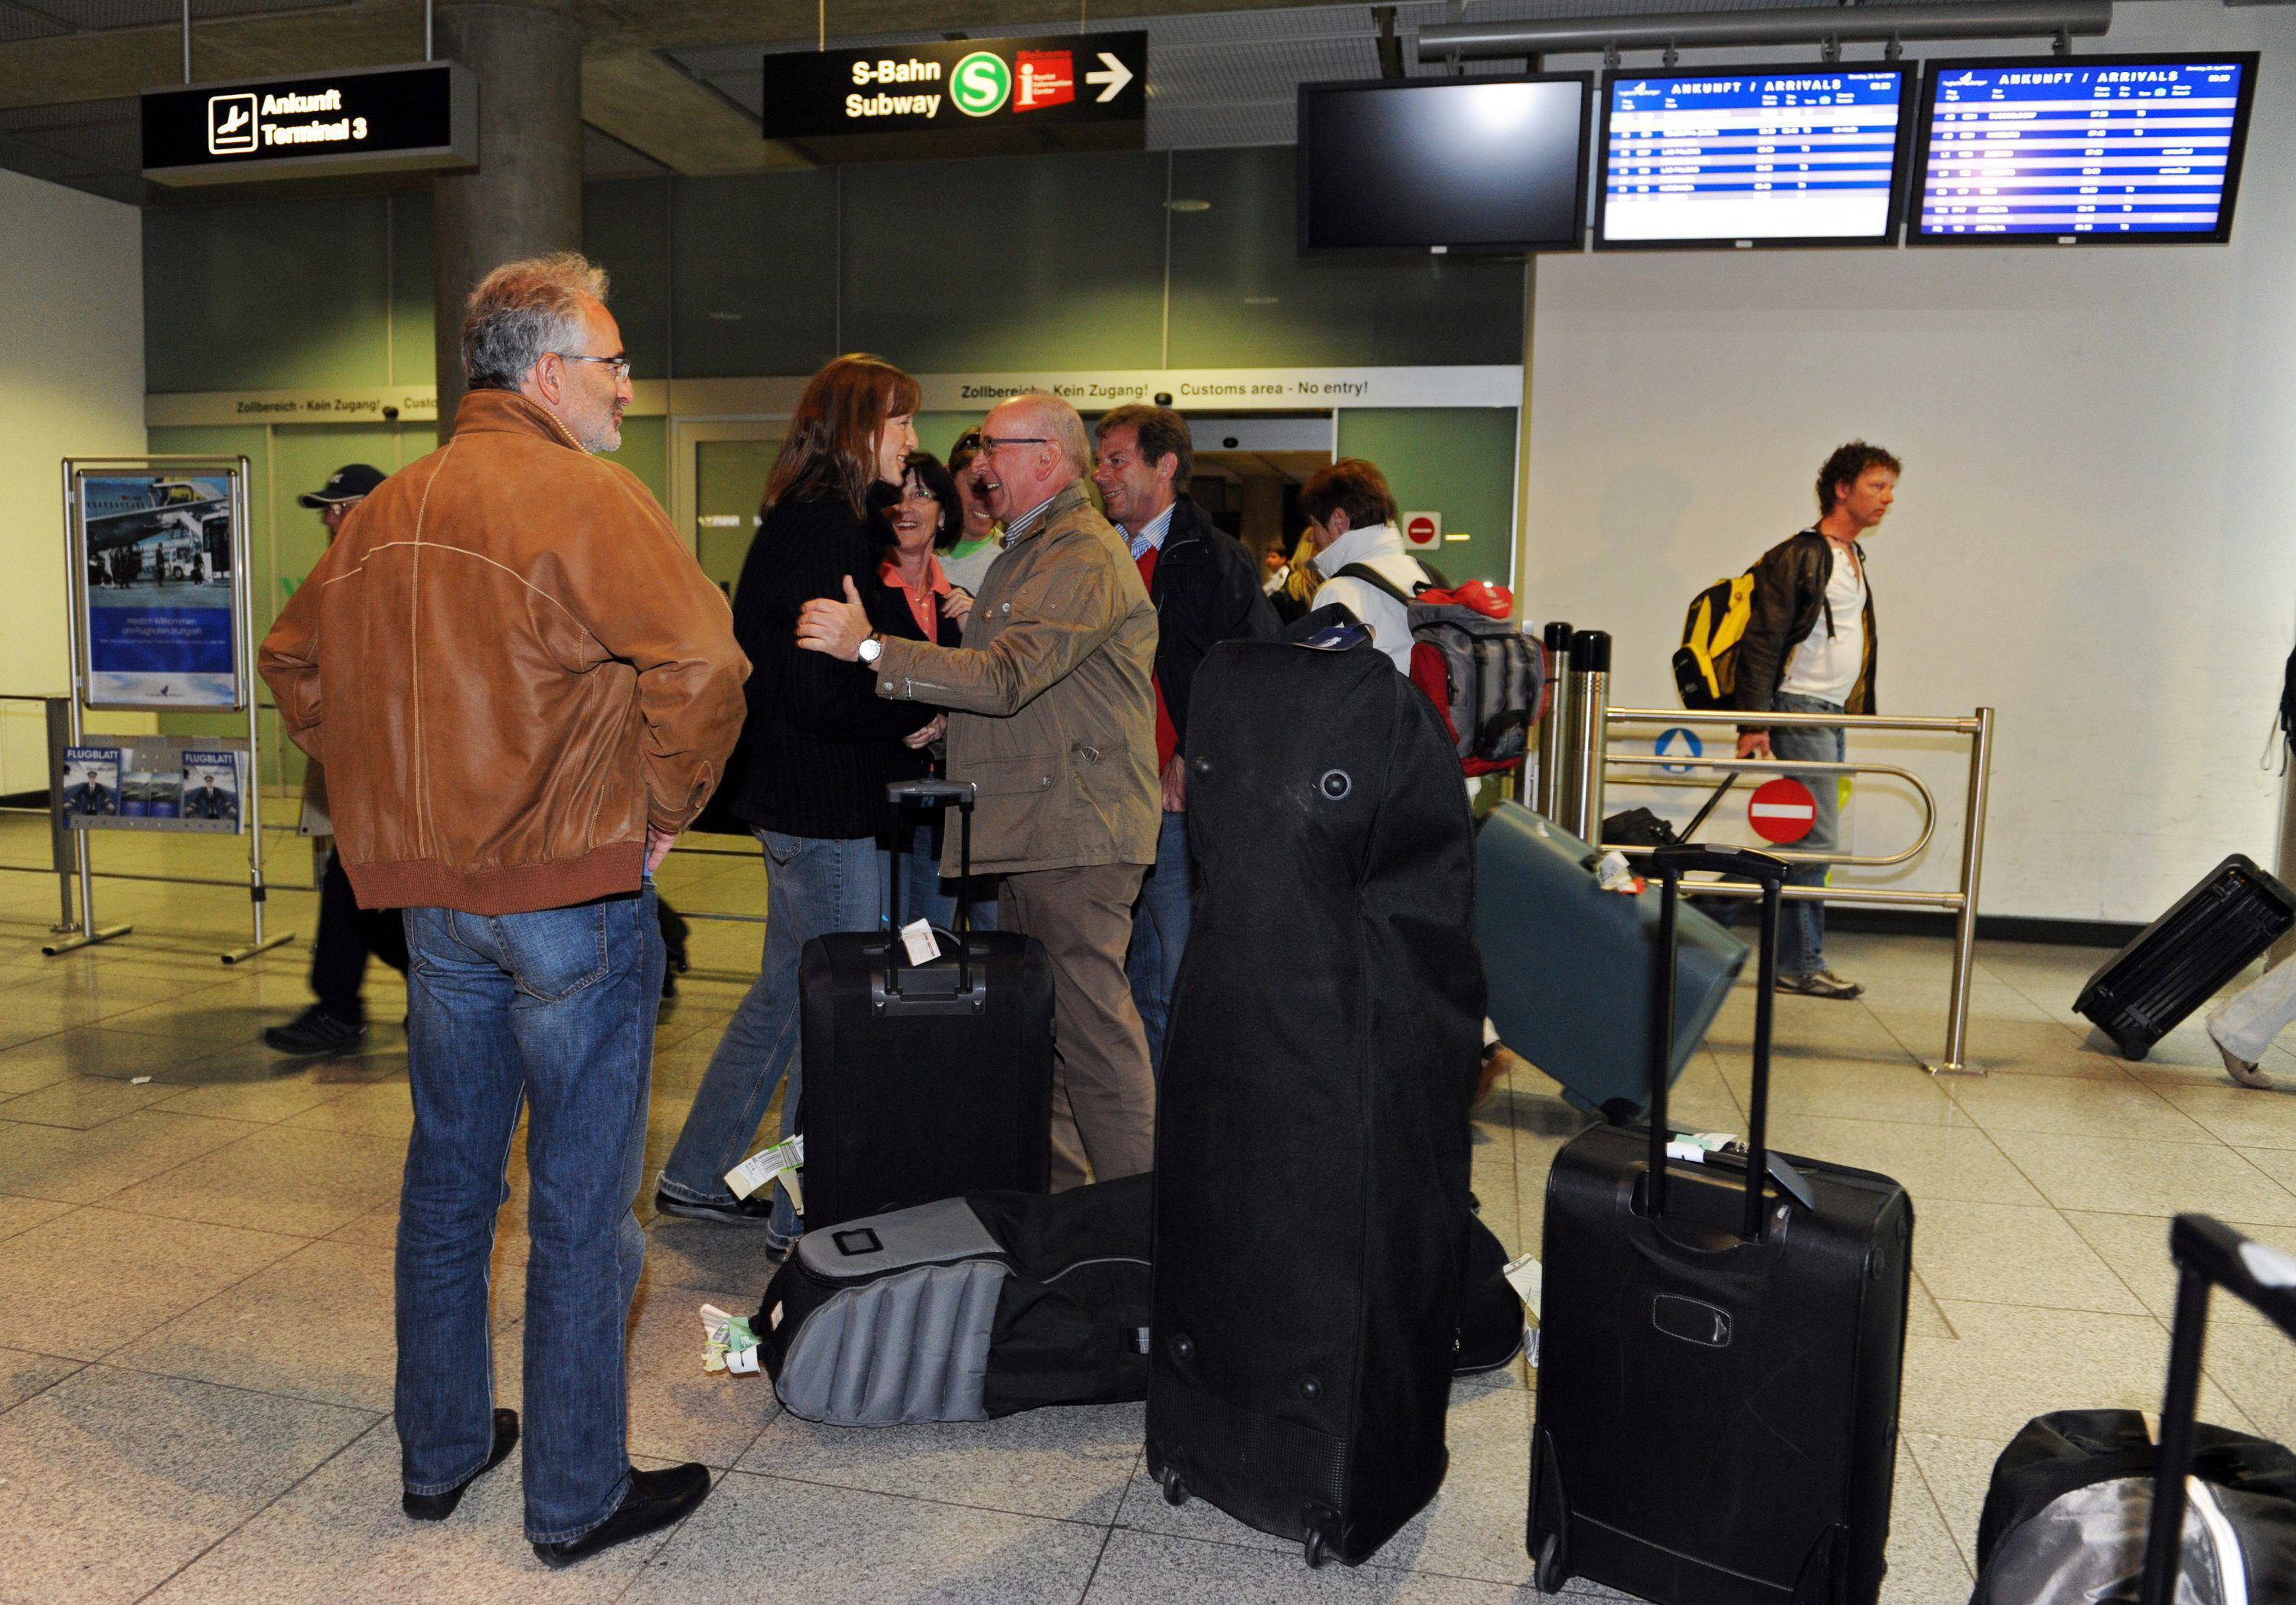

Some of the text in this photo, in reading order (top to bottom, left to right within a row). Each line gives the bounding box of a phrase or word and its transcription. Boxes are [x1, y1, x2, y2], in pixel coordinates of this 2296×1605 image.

[852, 58, 941, 85] S-Bahn
[1998, 73, 2073, 85] ANKUNFT
[2097, 70, 2178, 83] ARRIVALS
[961, 60, 999, 107] S
[1671, 82, 1742, 95] ANKUNFT
[1764, 79, 1841, 92] ARRIVALS
[261, 89, 341, 116] Ankunft
[845, 92, 941, 118] Subway
[261, 117, 367, 145] Terminal 3
[1054, 384, 1084, 396] Kein
[1089, 383, 1148, 399] Zugang!
[1180, 383, 1247, 395] Customs
[1251, 383, 1283, 394] area
[1298, 382, 1319, 394] No
[1323, 381, 1368, 396] entry!
[236, 400, 297, 413] Zollbereich
[307, 399, 332, 412] Kein
[334, 398, 380, 413] Zugang!
[67, 749, 118, 760] FLUGBLATT
[184, 753, 234, 764] FLUGBLATT
